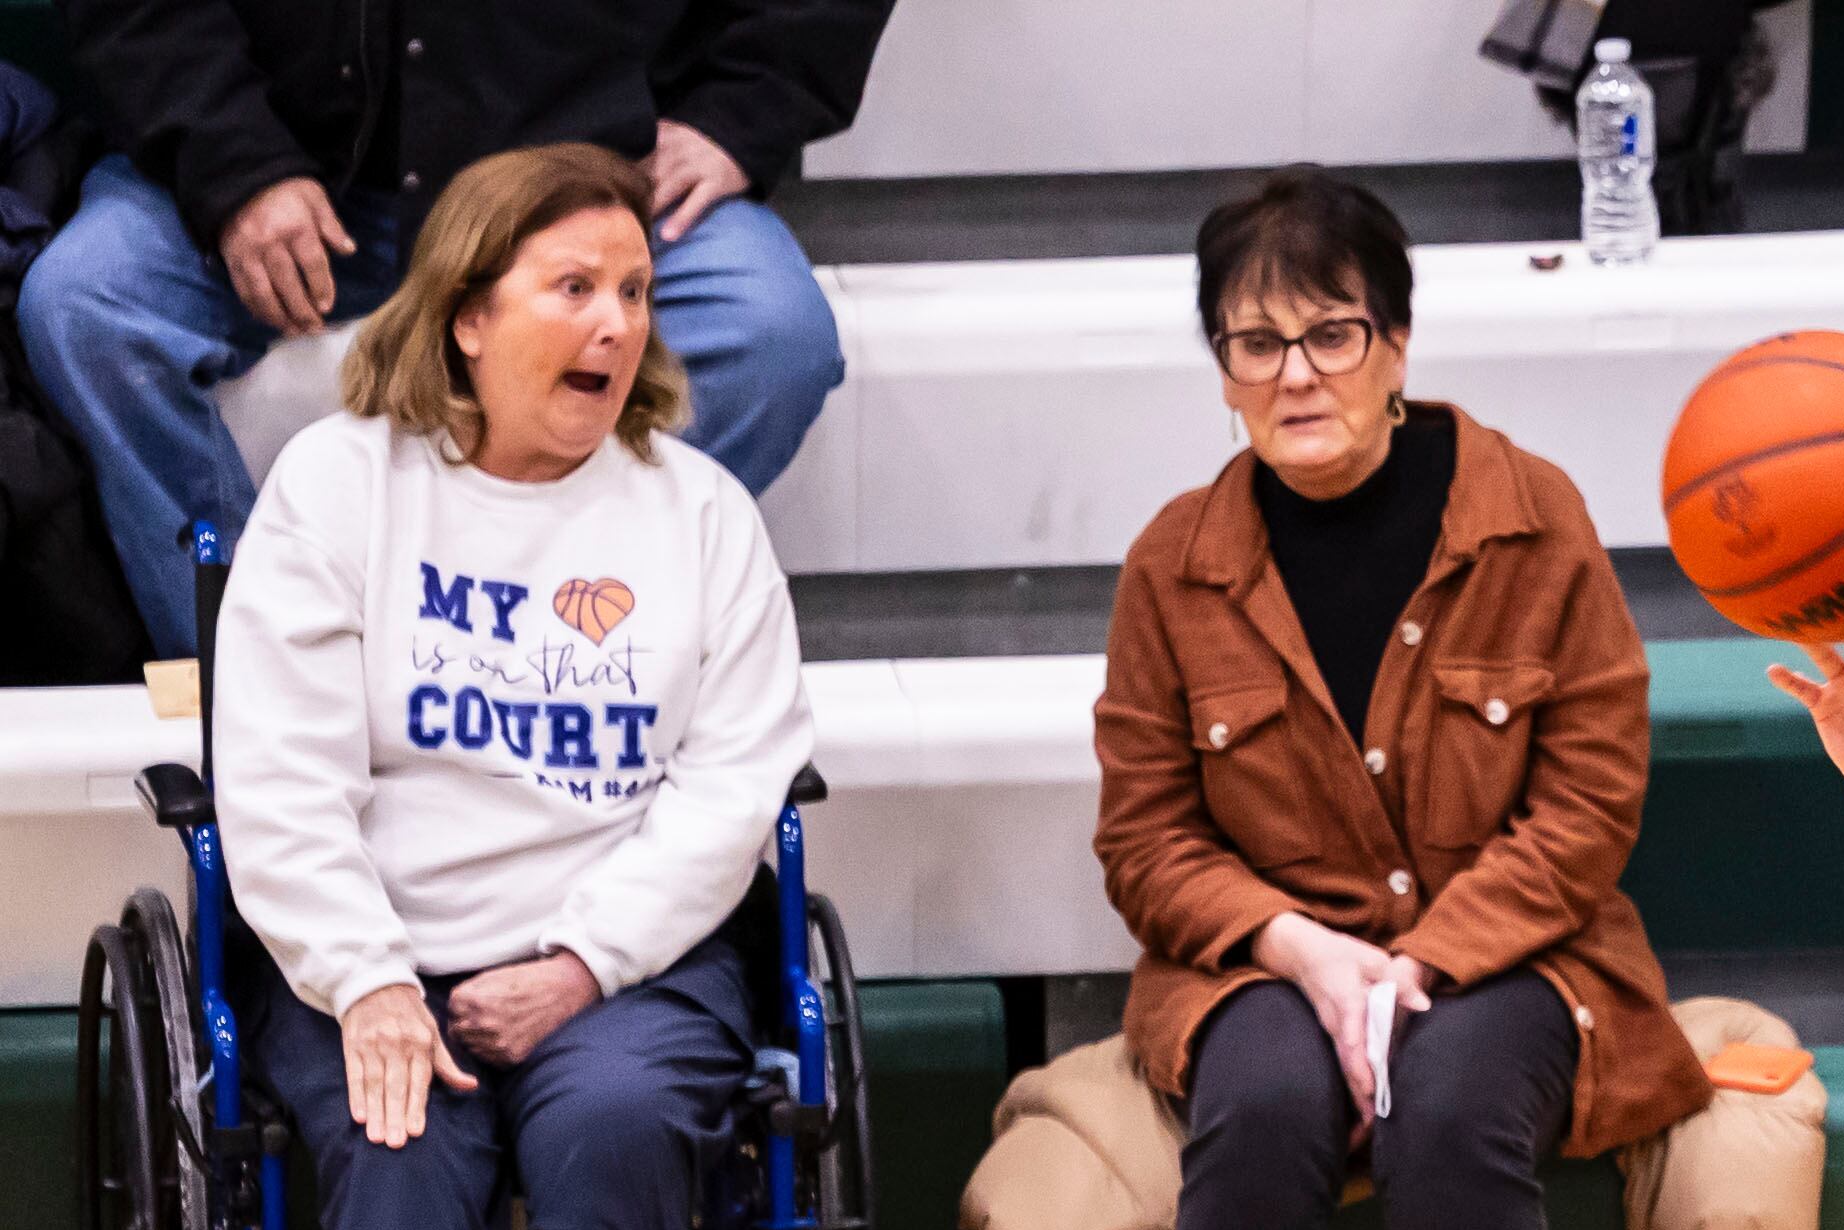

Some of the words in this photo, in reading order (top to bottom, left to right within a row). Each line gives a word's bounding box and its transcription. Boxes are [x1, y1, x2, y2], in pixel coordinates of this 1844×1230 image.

[418, 561, 529, 643] MY
[412, 634, 456, 675] is
[468, 654, 528, 685] on
[525, 634, 656, 696] that
[406, 684, 659, 770] COURT
